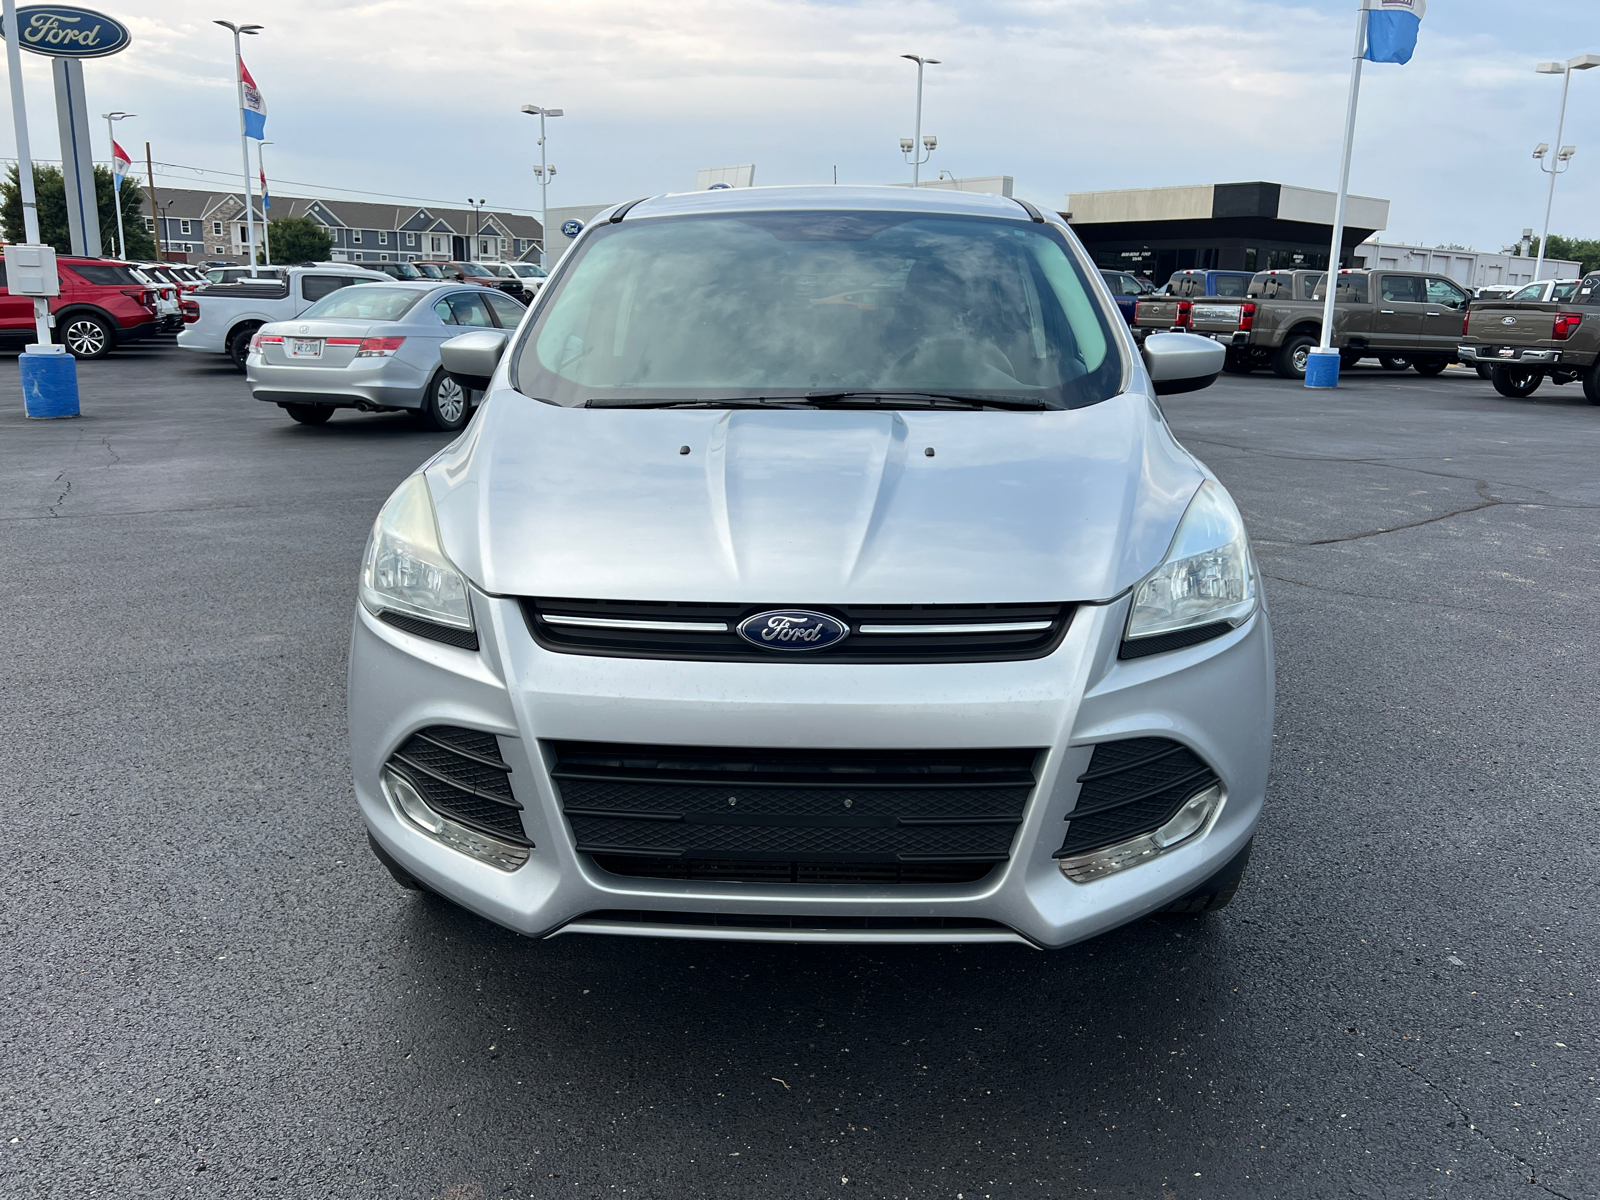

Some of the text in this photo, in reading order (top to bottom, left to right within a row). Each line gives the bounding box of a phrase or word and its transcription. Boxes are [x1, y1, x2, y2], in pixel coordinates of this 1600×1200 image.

[24, 13, 101, 46] Ford
[565, 222, 579, 234] Ford
[761, 616, 823, 642] Ford
